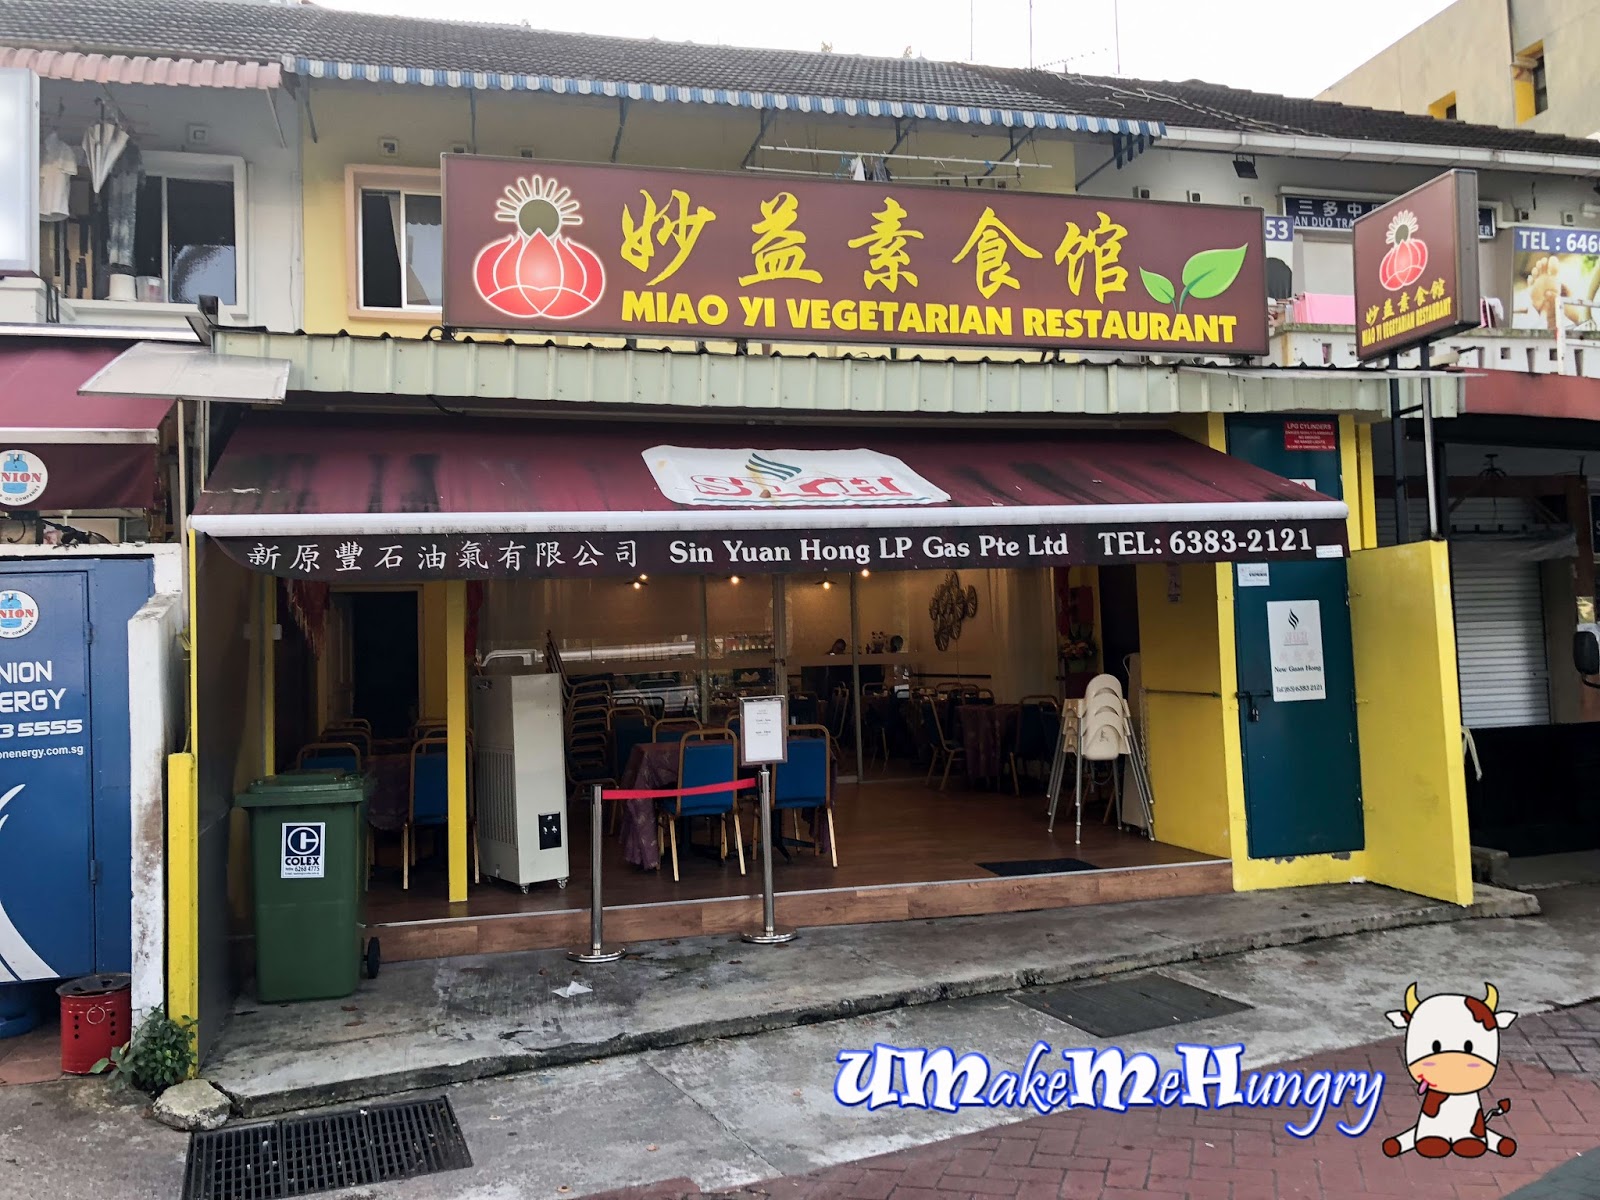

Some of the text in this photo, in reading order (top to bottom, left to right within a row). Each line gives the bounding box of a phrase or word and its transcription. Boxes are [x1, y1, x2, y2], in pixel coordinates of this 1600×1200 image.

[1298, 200, 1381, 218] 三多中
[1311, 217, 1333, 228] DUO
[619, 188, 1129, 304] 妙益素食馆
[1566, 233, 1600, 253] 646
[621, 290, 1237, 343] MIAO YI VEGETARIAN RESTAURANT
[669, 527, 1313, 564] Sin Yuan Hong LP Gas Pte Ltd TEL: 6383-2121
[246, 539, 639, 573] 新原豐石油氣有限公司
[18, 719, 83, 737] 5555
[285, 856, 320, 866] COLEX
